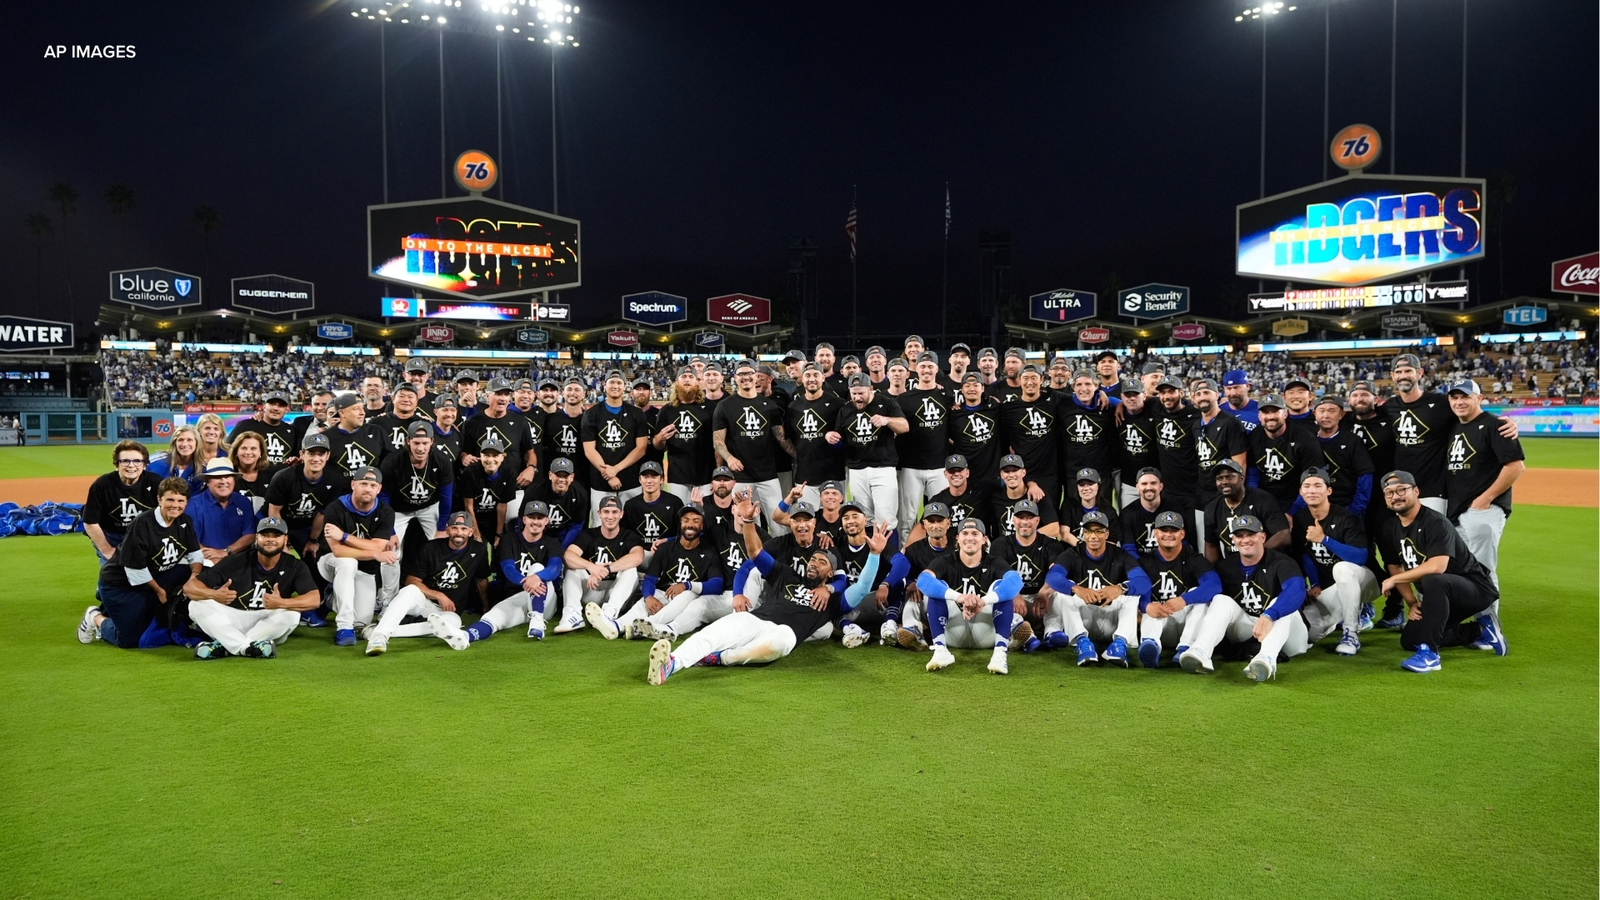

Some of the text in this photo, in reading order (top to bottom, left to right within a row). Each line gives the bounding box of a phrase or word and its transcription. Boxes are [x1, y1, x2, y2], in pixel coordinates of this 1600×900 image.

[1340, 135, 1371, 159] 76
[464, 162, 489, 181] 76
[1274, 233, 1296, 242] ON
[1307, 229, 1327, 239] TO
[1338, 224, 1371, 236] THE
[406, 240, 427, 249] ON
[437, 241, 455, 251] TO
[465, 243, 493, 253] THE
[119, 273, 170, 293] blue
[238, 289, 308, 299] GUGGENHEIM
[127, 292, 175, 302] california
[630, 302, 677, 314] Spectrum
[1043, 299, 1081, 308] ULTRA
[1144, 291, 1182, 303] Security
[1145, 301, 1178, 311] Benefit
[1508, 309, 1541, 322] TEL
[426, 328, 449, 338] JINRO
[1079, 331, 1108, 340] Churu
[743, 407, 760, 430] LA
[922, 398, 940, 420] LA
[1026, 406, 1047, 429] LA
[156, 423, 171, 434] 76
[606, 420, 621, 441] LA
[679, 411, 694, 432] LA
[803, 410, 817, 432] LA
[856, 413, 872, 436] LA
[968, 414, 990, 436] LA
[1075, 415, 1093, 437] LA
[1161, 418, 1177, 440] LA
[1398, 411, 1417, 437] LA
[266, 433, 285, 455] LA
[561, 425, 577, 447] LA
[1126, 424, 1143, 447] LA
[345, 444, 366, 469] LA
[1198, 437, 1211, 461] LA
[1450, 434, 1465, 462] LA
[1264, 448, 1284, 474] LA
[410, 476, 428, 499] LA
[479, 488, 496, 506] LA
[120, 498, 142, 522] LA
[296, 493, 315, 512] LA
[548, 504, 563, 524] LA
[644, 513, 659, 536] LA
[162, 538, 178, 565] LA
[726, 542, 743, 568] LA
[1400, 539, 1419, 569] LA
[441, 562, 459, 583] LA
[675, 558, 691, 582] LA
[1017, 554, 1033, 580] LA
[1159, 572, 1177, 599] LA
[1241, 582, 1262, 609] LA
